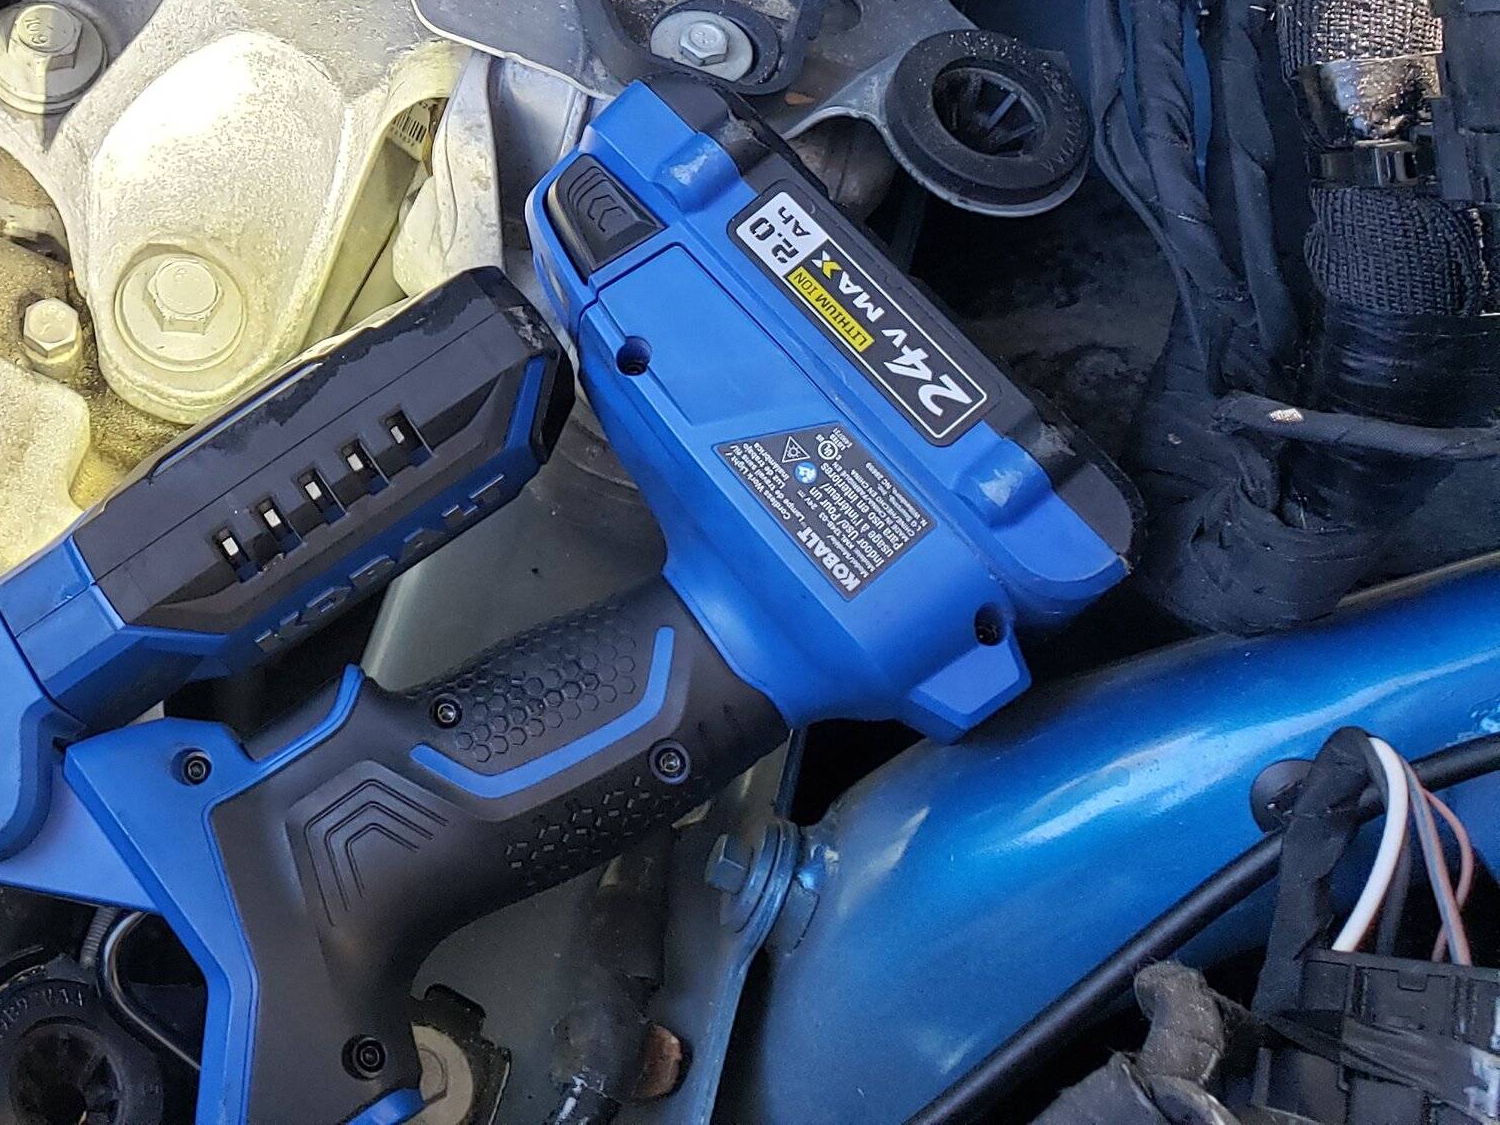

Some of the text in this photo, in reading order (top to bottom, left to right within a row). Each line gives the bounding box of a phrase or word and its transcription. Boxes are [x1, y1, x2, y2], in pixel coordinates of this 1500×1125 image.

[774, 204, 810, 240] Ah
[748, 215, 799, 264] 2.0
[811, 250, 885, 322] MAX
[794, 271, 868, 346] LITHIUM ION
[821, 443, 834, 456] UL
[730, 453, 750, 474] Light
[740, 453, 757, 469] sans
[741, 441, 785, 488] Luz de trabajo
[752, 441, 789, 480] inalámbrica
[831, 461, 842, 472] EN
[745, 471, 765, 491] Work
[753, 467, 776, 491] travail
[849, 468, 869, 489] CHINA
[880, 478, 892, 489] NC
[762, 489, 791, 519] Cordless
[773, 488, 785, 500] de
[803, 495, 817, 510] 24V
[782, 497, 805, 521] Lampe
[855, 499, 869, 513] en
[808, 486, 884, 567] Indoor Use/ Pour un
[819, 480, 894, 557] usage à l'intérieur/
[866, 511, 884, 529] uso
[839, 533, 854, 549] KML
[880, 527, 903, 549] Para
[890, 523, 909, 542] MADE
[796, 524, 861, 591] KOBALT
